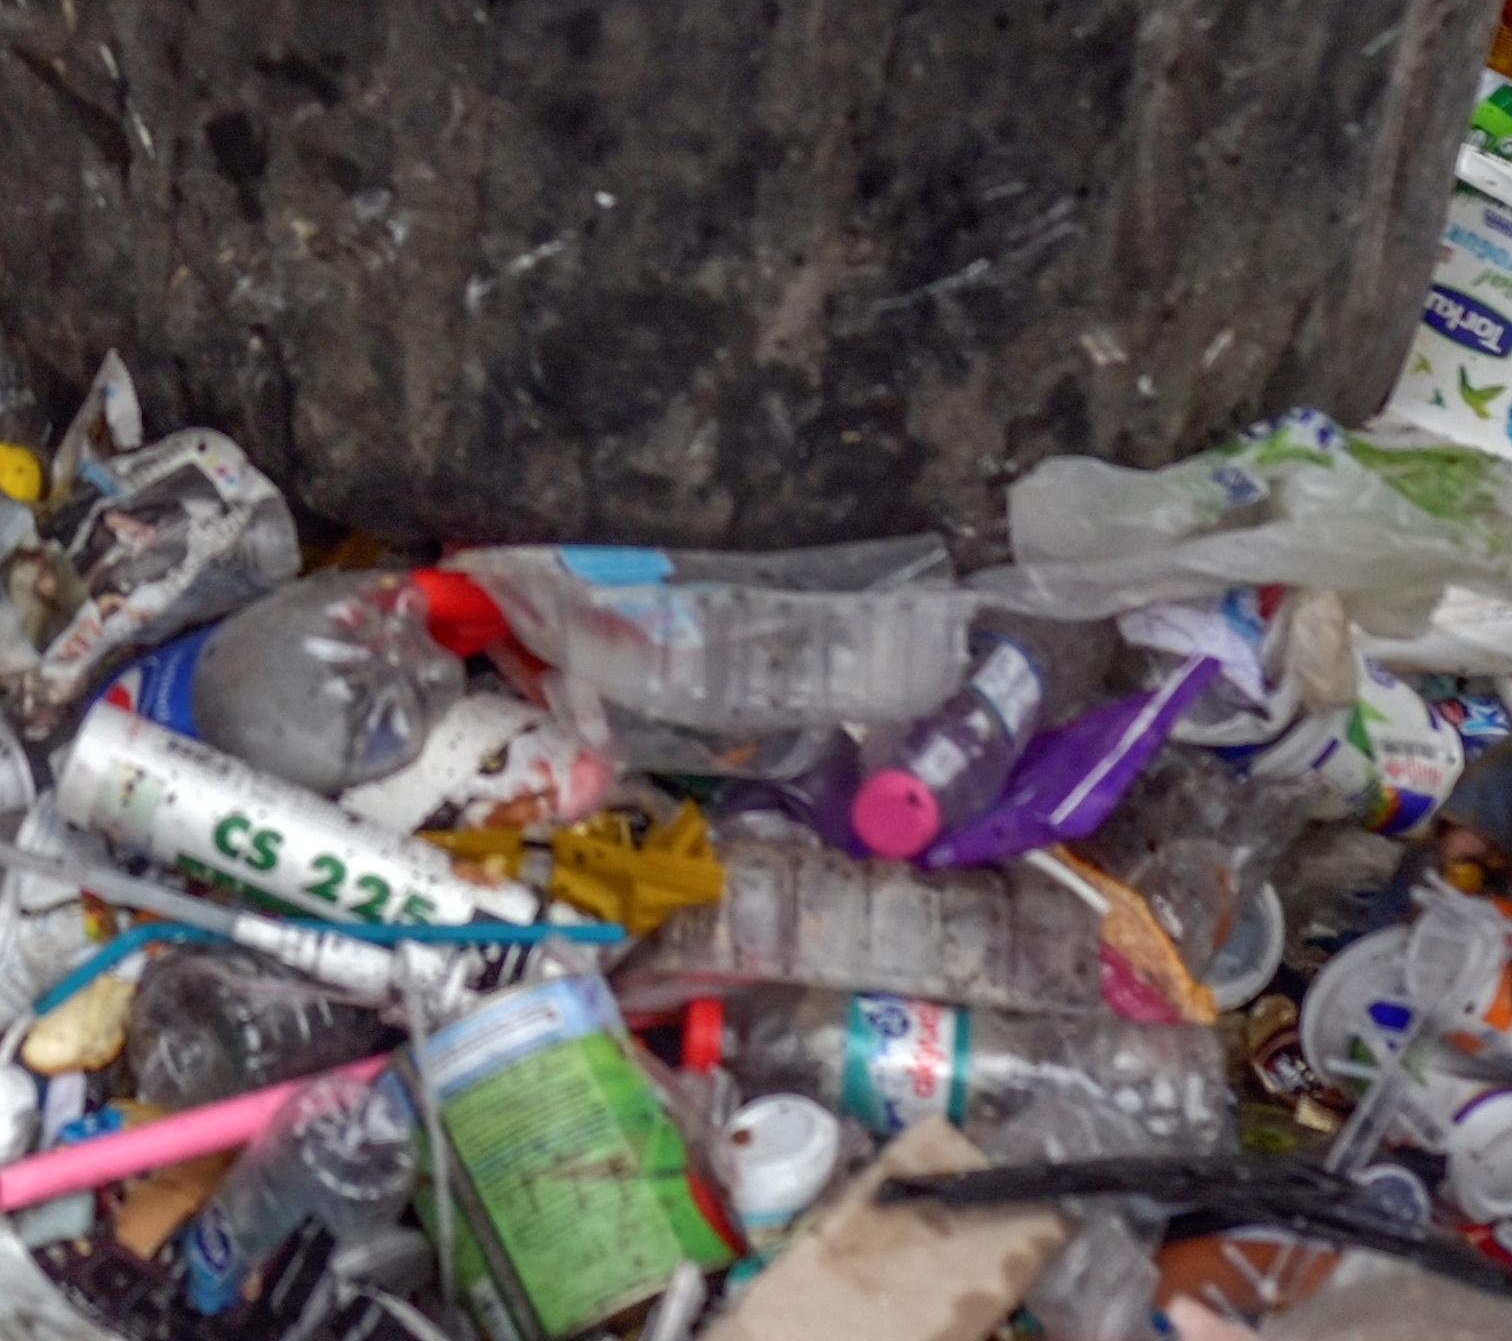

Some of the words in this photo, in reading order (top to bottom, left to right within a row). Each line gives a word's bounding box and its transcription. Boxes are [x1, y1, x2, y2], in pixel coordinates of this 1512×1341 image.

[1423, 290, 1505, 353] Torku
[213, 815, 284, 871] CS
[304, 853, 439, 928] 225
